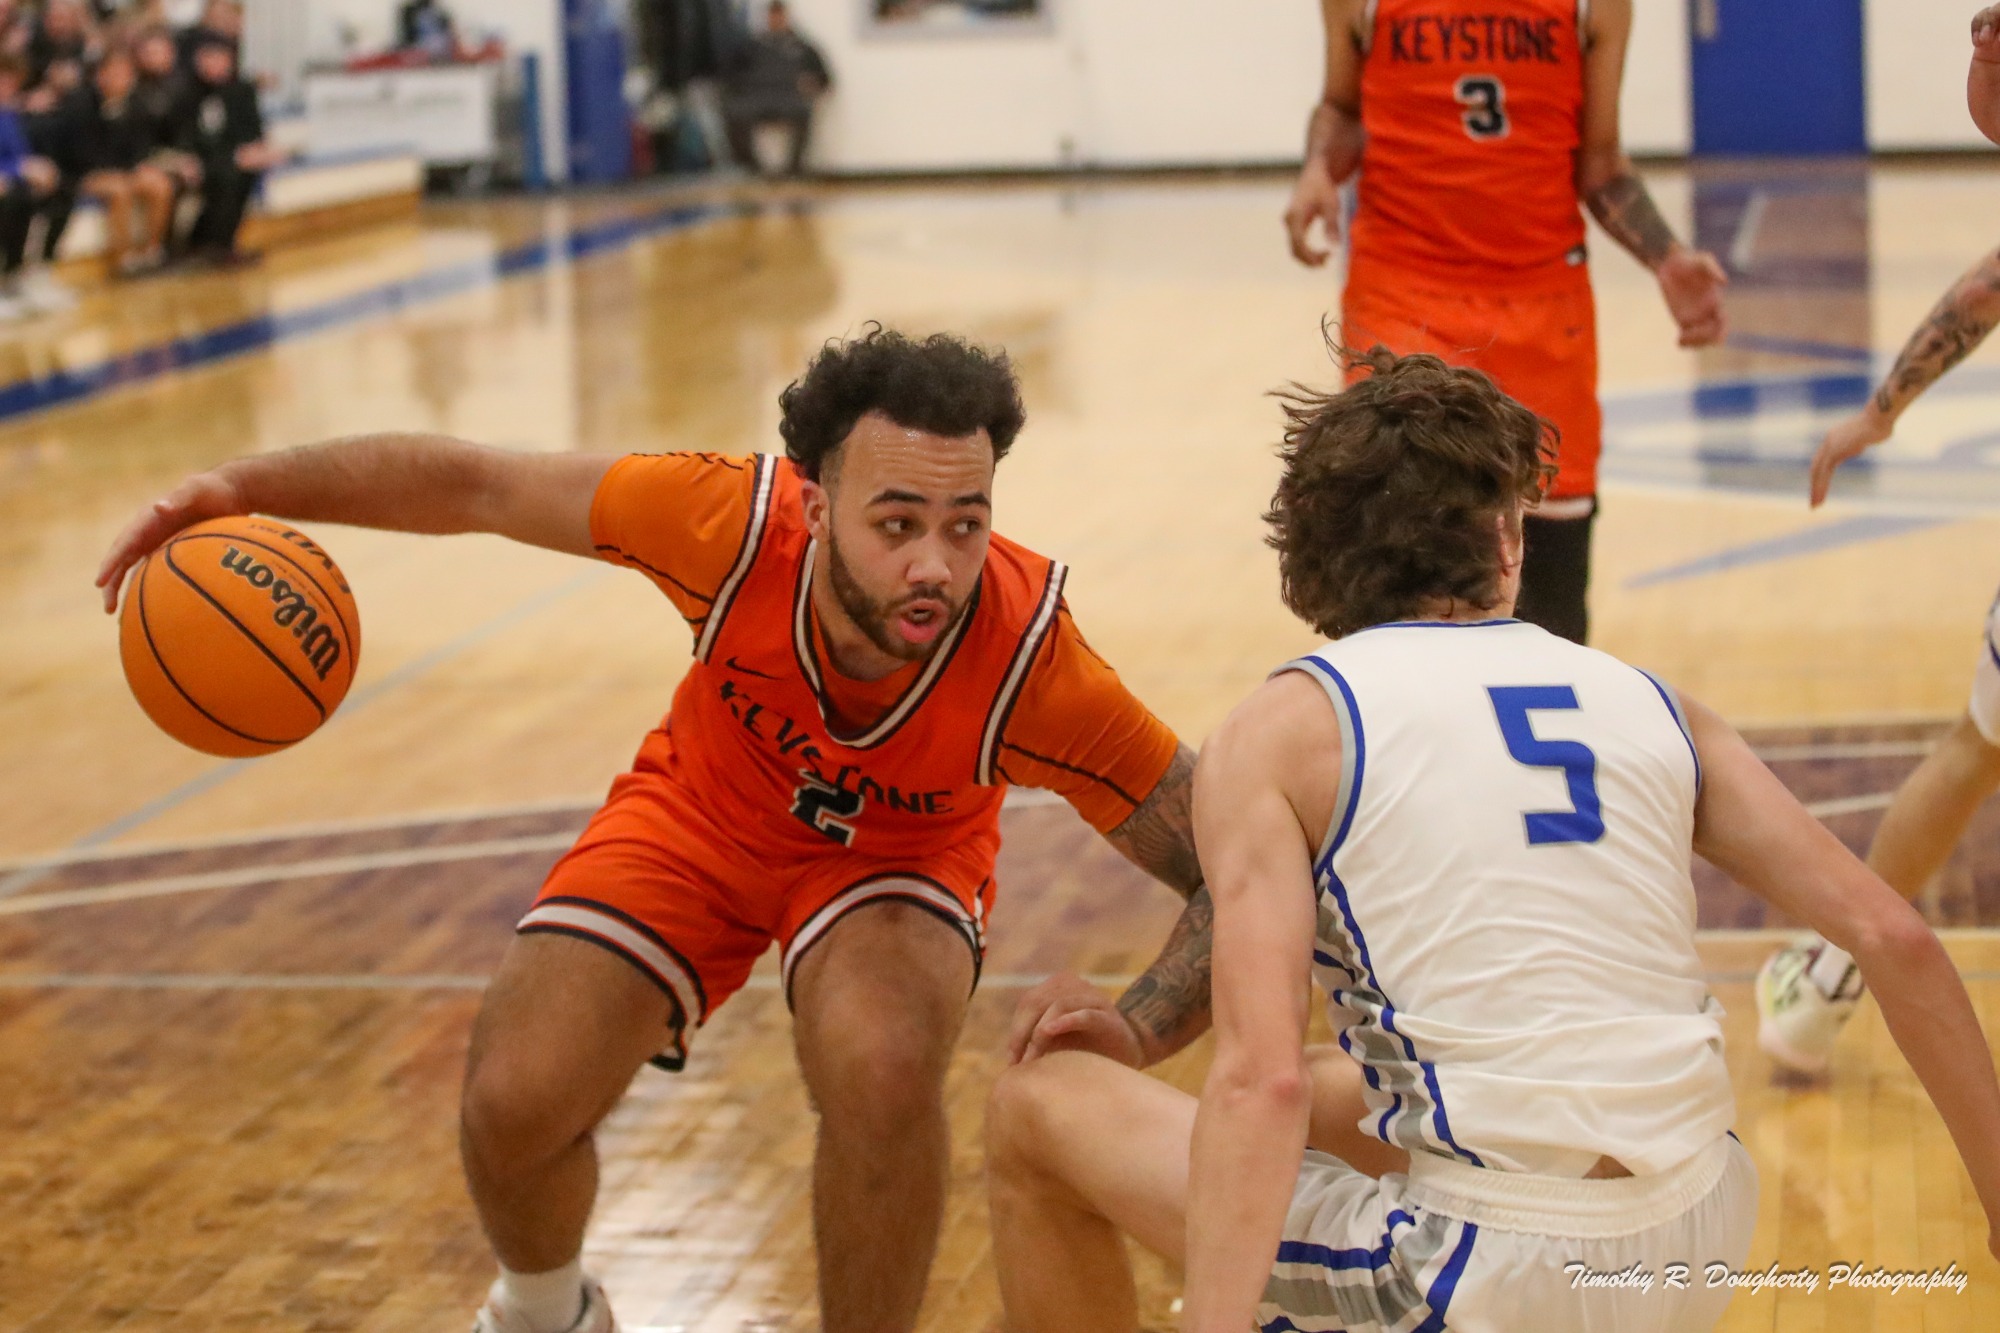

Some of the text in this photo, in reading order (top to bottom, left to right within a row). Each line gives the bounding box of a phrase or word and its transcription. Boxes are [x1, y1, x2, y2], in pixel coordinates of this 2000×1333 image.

[1390, 15, 1561, 64] KEYSTONE
[1453, 74, 1511, 141] 3
[220, 546, 341, 682] Wilson
[1483, 684, 1606, 848] 5
[789, 767, 865, 848] 2
